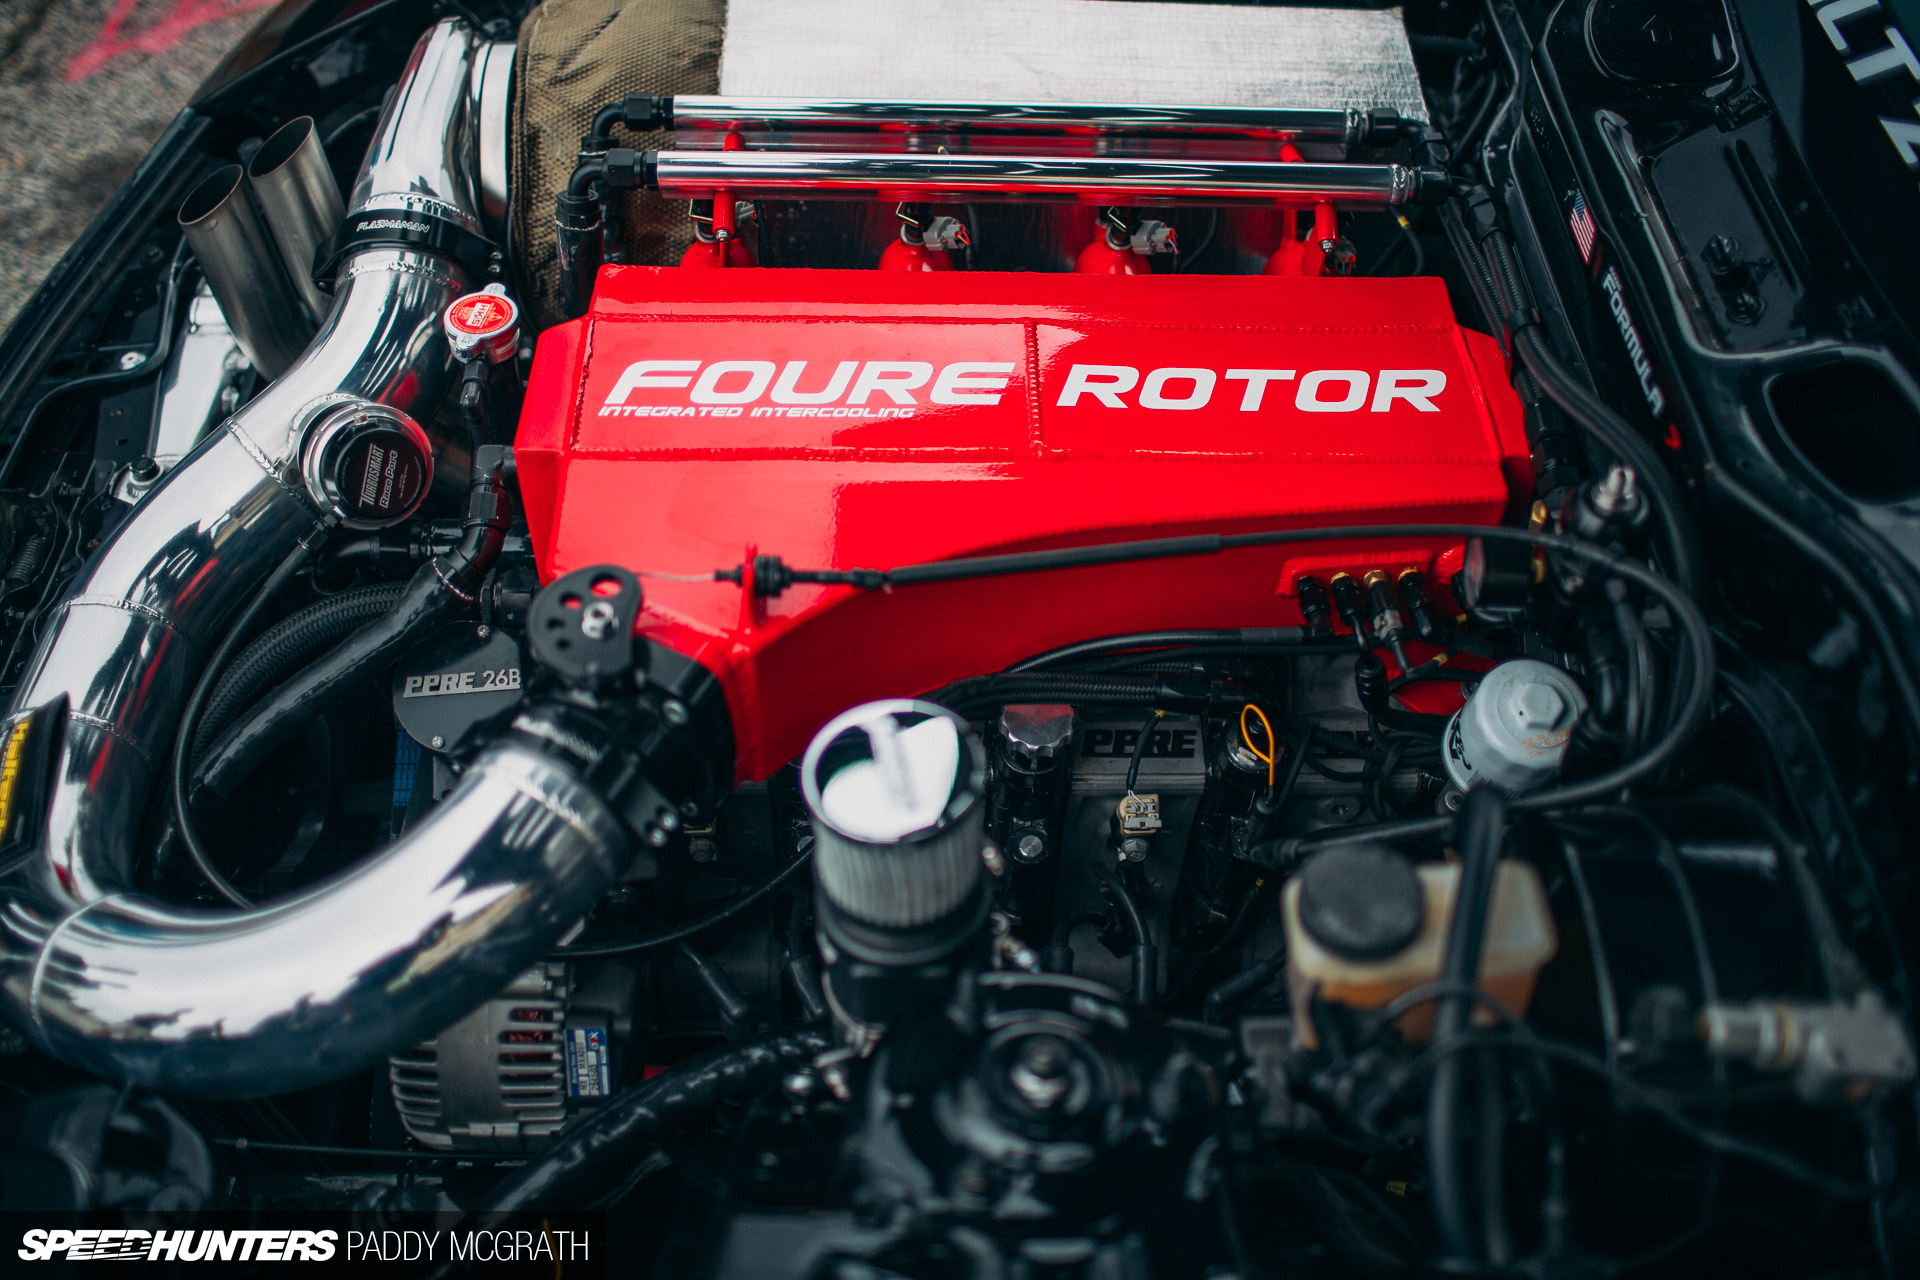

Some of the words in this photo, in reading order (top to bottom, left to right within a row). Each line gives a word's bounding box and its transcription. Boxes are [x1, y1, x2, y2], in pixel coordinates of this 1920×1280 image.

[1806, 0, 1920, 82] LT
[356, 219, 431, 233] PLAZMAMAN
[471, 303, 489, 326] HKS
[1602, 272, 1665, 417] FORMULA
[603, 360, 1016, 405] FOURE
[1056, 363, 1447, 412] ROTOR
[597, 406, 744, 417] INTEGRATED
[750, 407, 916, 418] INTERCOOLING
[359, 443, 385, 507] TURBOSMART
[385, 449, 399, 480] Port
[379, 478, 393, 509] Race
[403, 671, 476, 698] PPRE
[481, 668, 521, 690] 26B
[1081, 728, 1199, 759] PPRE
